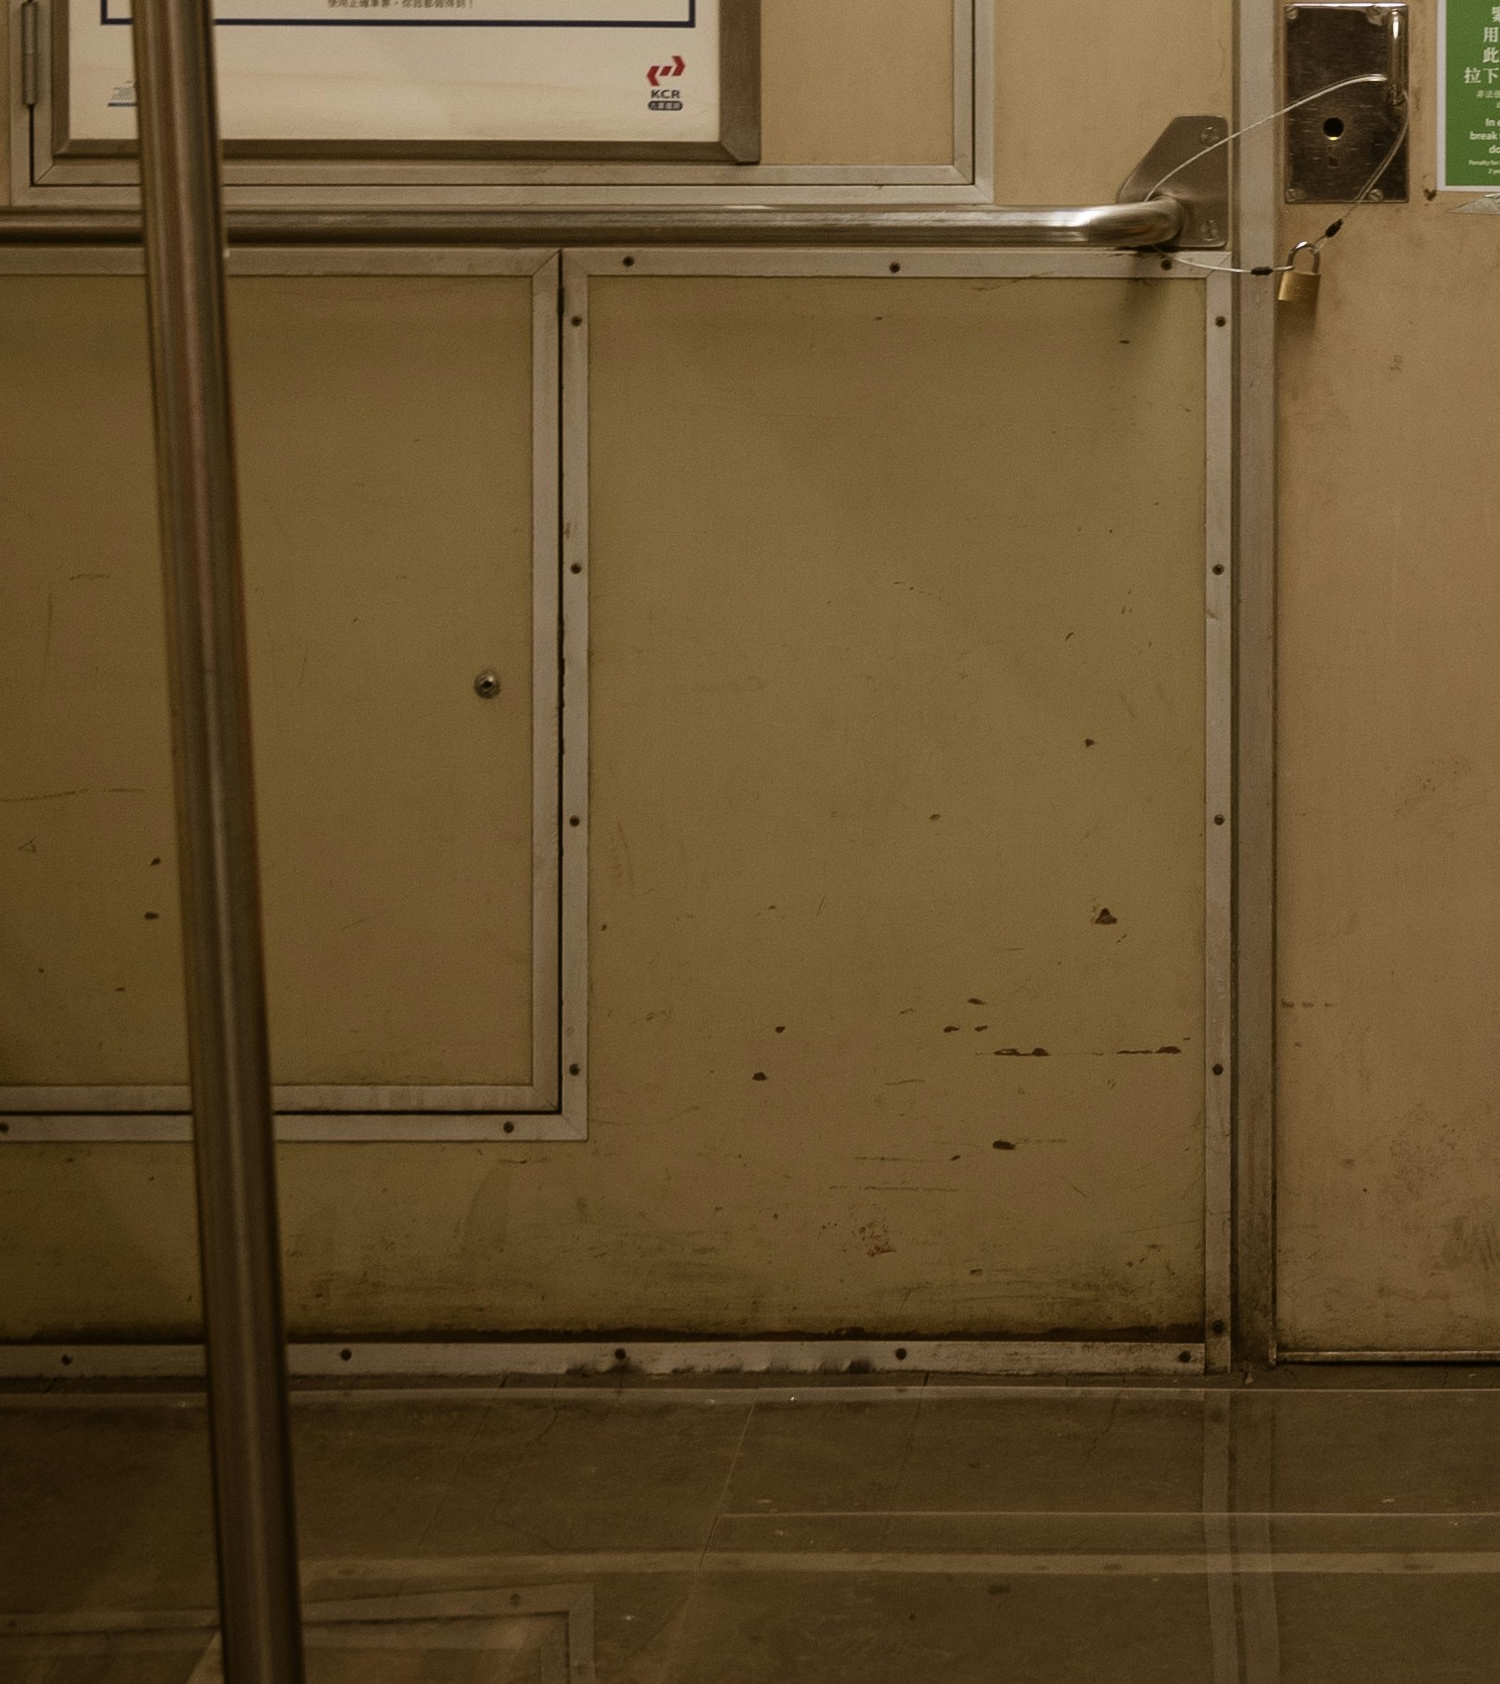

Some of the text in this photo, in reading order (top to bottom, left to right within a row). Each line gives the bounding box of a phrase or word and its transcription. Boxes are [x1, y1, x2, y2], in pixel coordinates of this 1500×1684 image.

[651, 89, 681, 99] KCR
[1485, 117, 1495, 127] In
[1469, 131, 1498, 141] break
